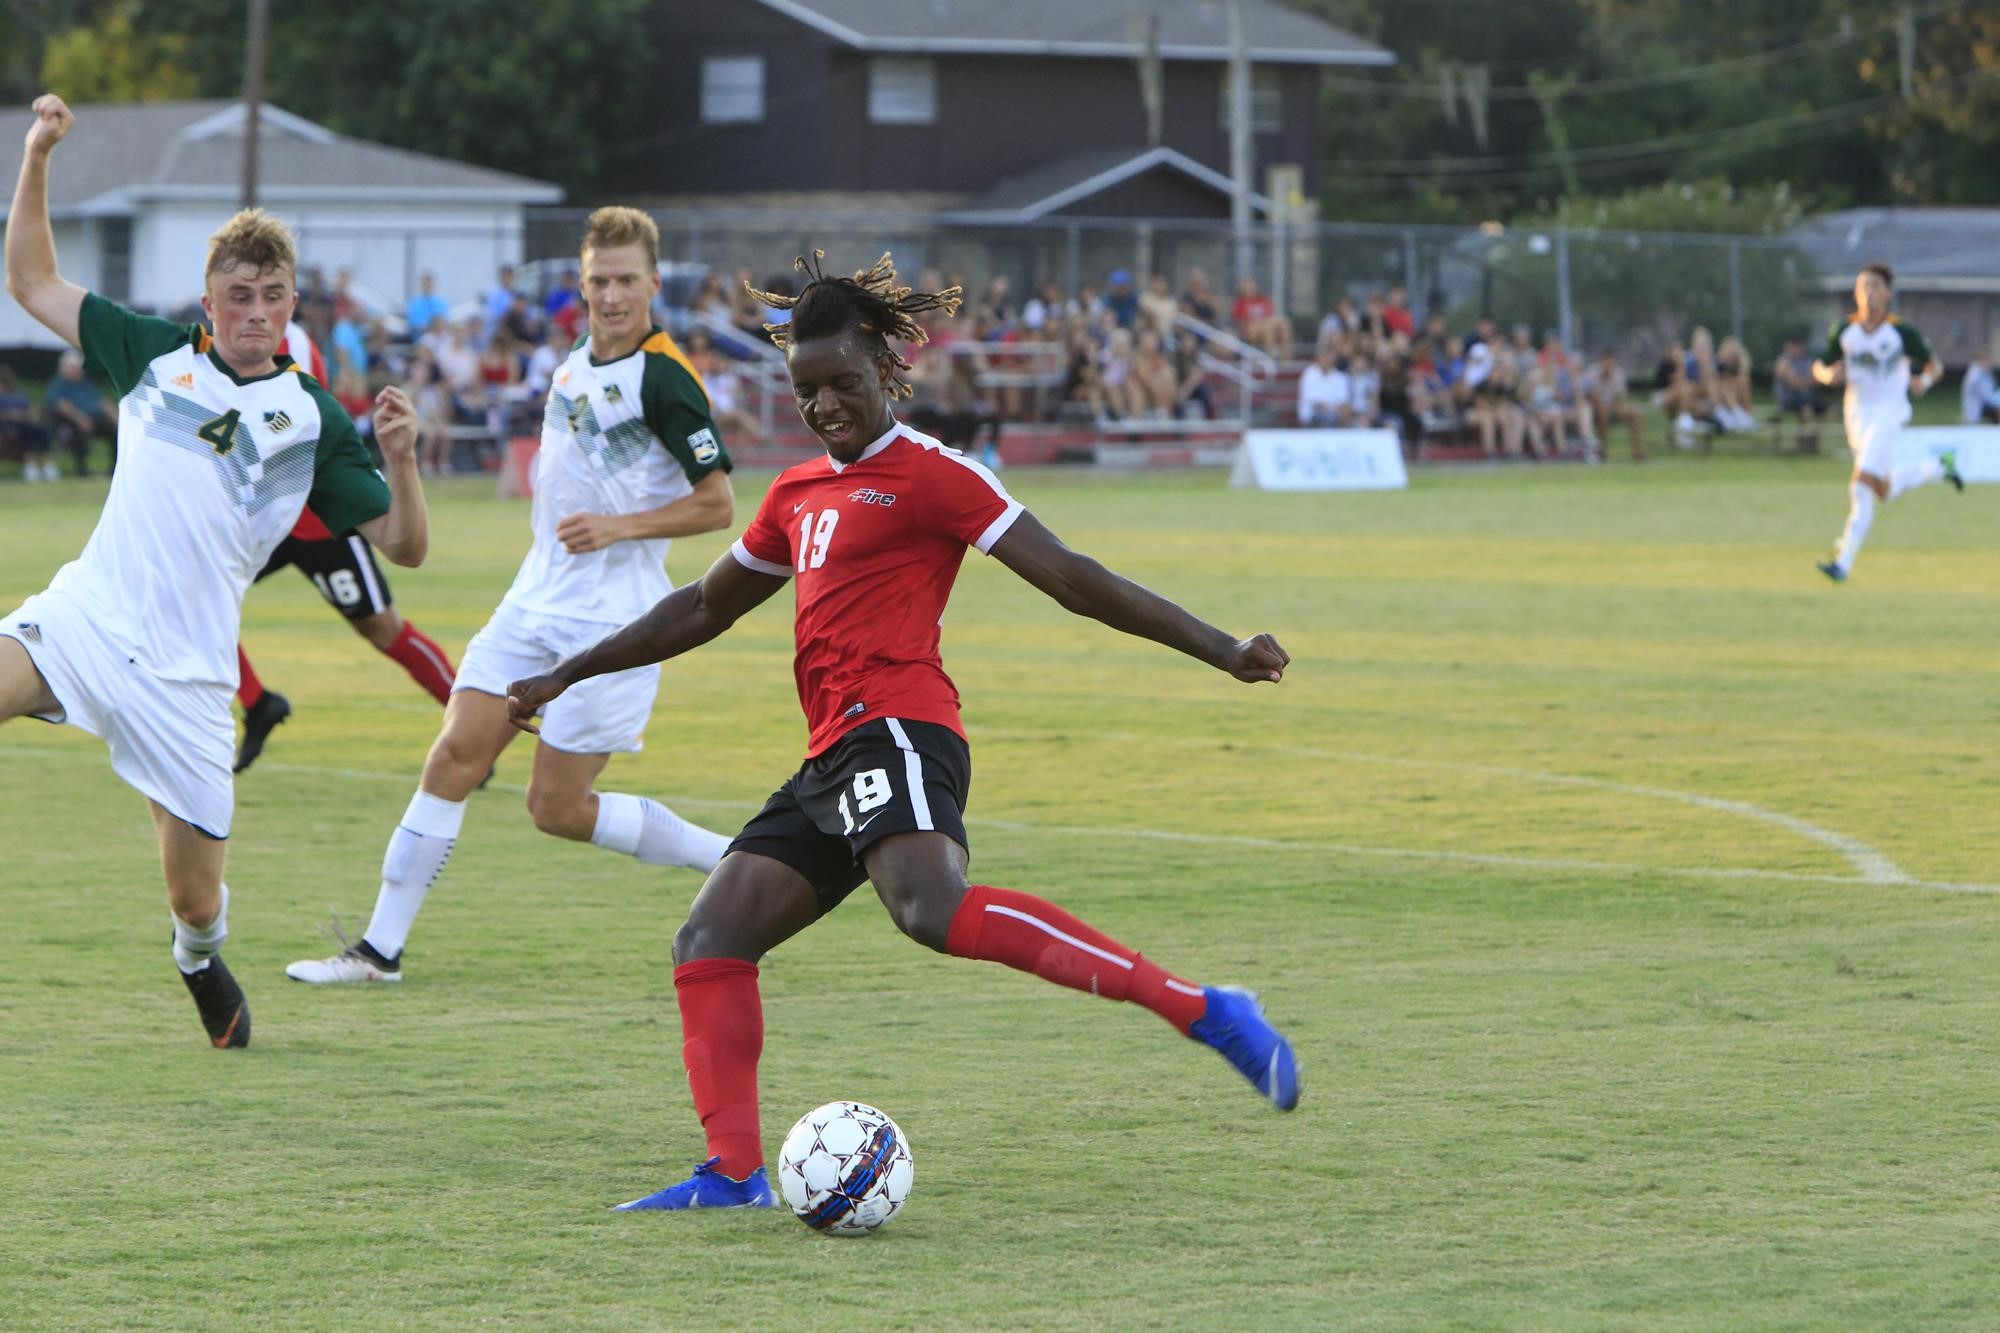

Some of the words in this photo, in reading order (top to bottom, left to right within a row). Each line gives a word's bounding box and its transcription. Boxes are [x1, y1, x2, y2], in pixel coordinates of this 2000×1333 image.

[196, 407, 241, 457] 4
[847, 488, 896, 507] Fire
[797, 508, 840, 574] 19
[313, 568, 362, 606] 16
[838, 768, 893, 837] 19
